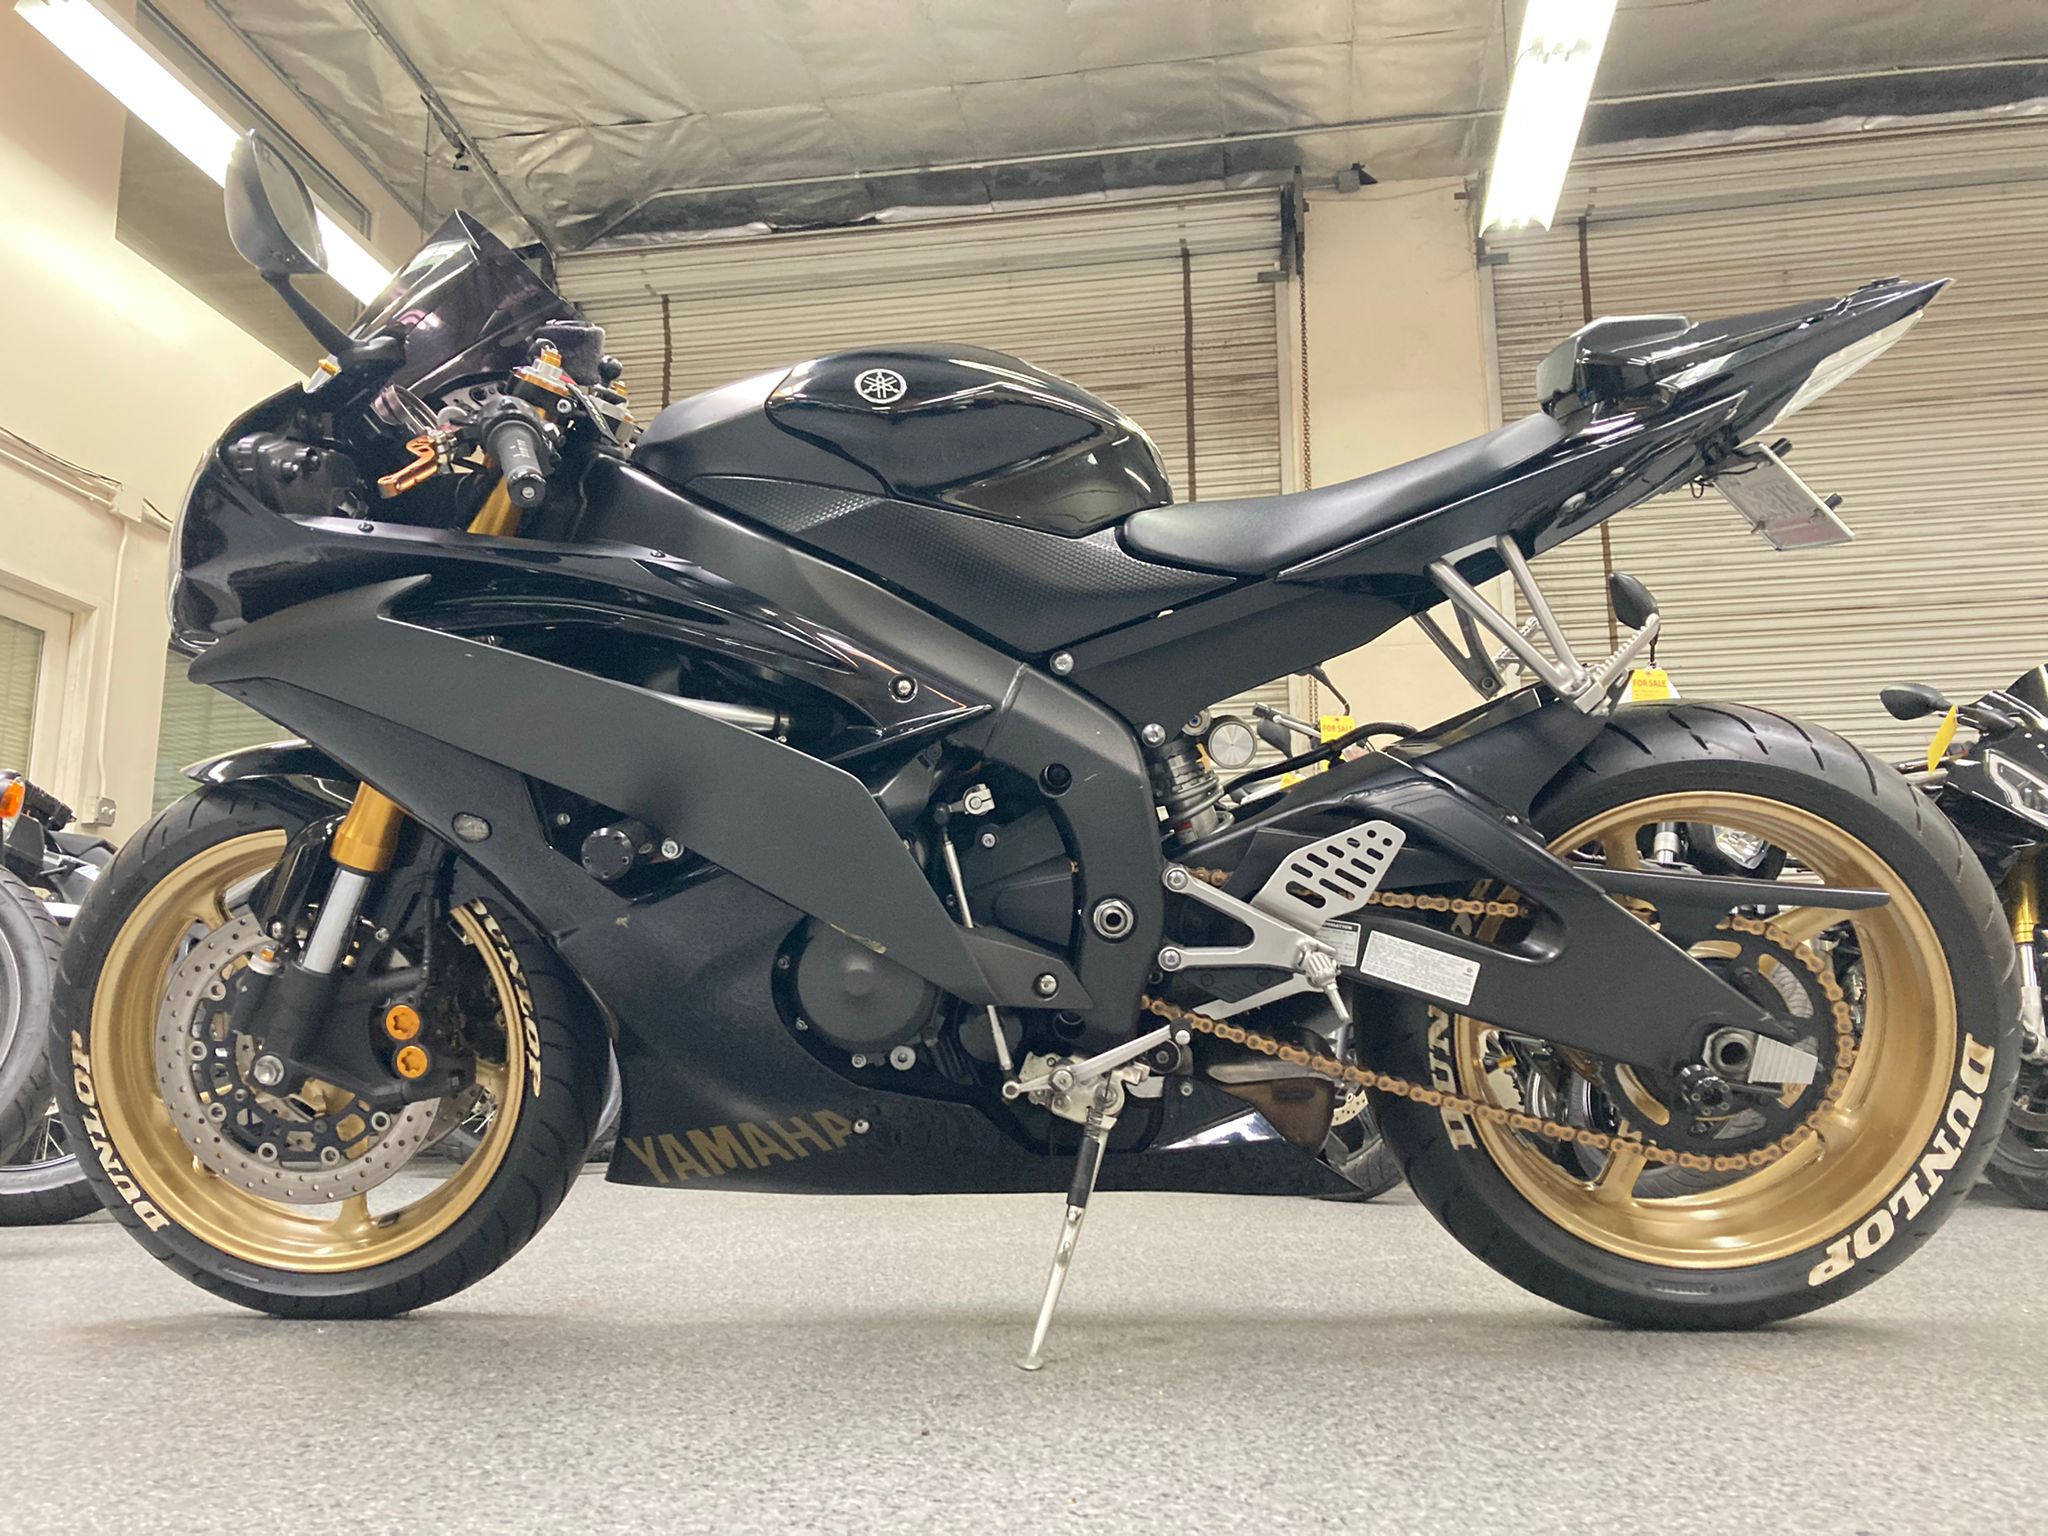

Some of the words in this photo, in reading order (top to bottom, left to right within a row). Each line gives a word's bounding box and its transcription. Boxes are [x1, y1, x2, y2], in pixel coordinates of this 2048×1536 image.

[1322, 724, 1336, 732] FOR
[1632, 679, 1648, 687] FOR
[1649, 679, 1667, 687] SALE
[71, 1029, 170, 1232] DUNLOP
[1427, 1004, 1478, 1150] DUN
[623, 1109, 853, 1184] YAMAHA
[1808, 1032, 1995, 1286] DUNLOP
